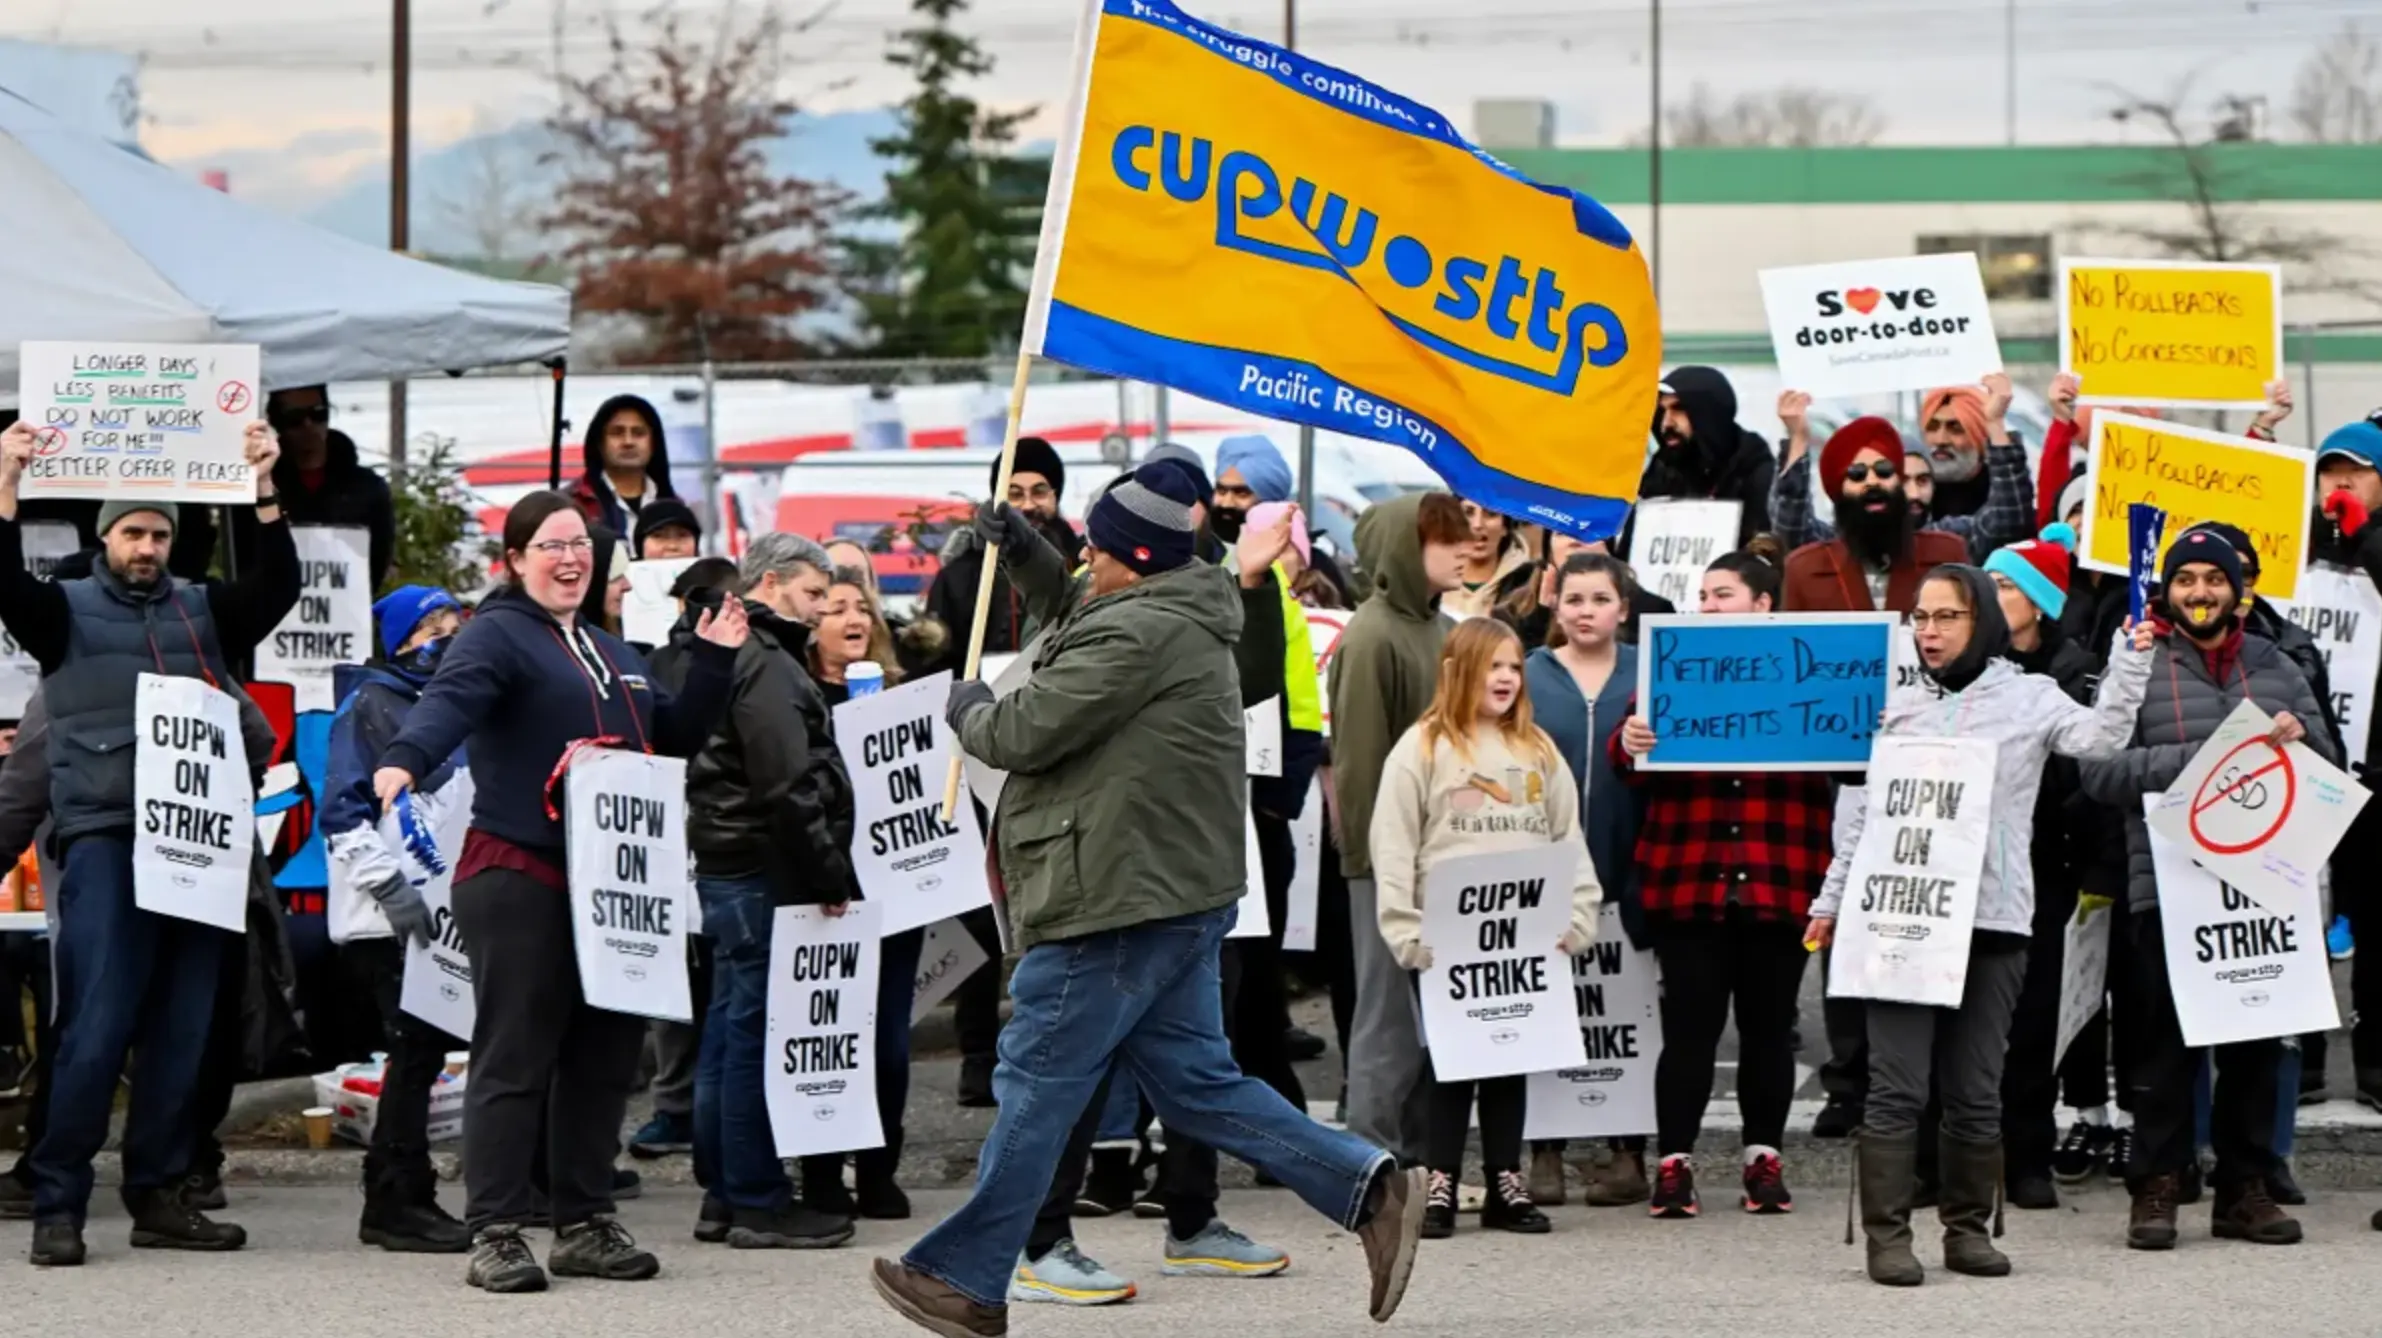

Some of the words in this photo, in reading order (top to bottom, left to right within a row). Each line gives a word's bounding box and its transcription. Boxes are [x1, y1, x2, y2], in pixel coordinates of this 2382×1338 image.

[1186, 24, 1293, 76] ruggle
[1795, 316, 1970, 347] door-to-door
[72, 354, 147, 371] LONGER
[159, 356, 199, 374] DAYS
[54, 382, 95, 398] LESS
[107, 383, 187, 399] BENEFITS
[1239, 364, 1323, 409] Pacific
[1334, 385, 1439, 452] Region
[46, 408, 78, 426] DO
[90, 408, 135, 425] NOT
[146, 409, 204, 428] WORK
[82, 430, 119, 447] FOR
[30, 456, 109, 478] BETTER
[119, 458, 175, 478] OFFER
[1648, 535, 1714, 566] CUPW
[300, 561, 348, 589] UPW
[1658, 572, 1688, 603] ON
[300, 596, 331, 624] ON
[275, 631, 354, 660] STRIKE
[152, 715, 226, 760] CUPW
[863, 715, 933, 768] CUPW
[175, 759, 210, 798] ON
[888, 763, 923, 804] ON
[2216, 765, 2268, 810] SSD
[594, 792, 666, 839] CUPW
[1885, 778, 1965, 820] CUPW
[145, 799, 233, 850] STRIKE
[616, 843, 647, 884] ON
[1893, 826, 1933, 866] ON
[591, 888, 673, 937] STRIKE
[1458, 878, 1546, 916] CUPW
[1861, 874, 1956, 918] STRIKE
[1478, 918, 1518, 952] ON
[2194, 915, 2299, 963] STRIKE
[793, 942, 860, 982] CUPW
[1448, 956, 1549, 1001] STRIKE
[809, 989, 839, 1026] ON
[783, 1033, 859, 1075] STRIKE
[1580, 1024, 1640, 1060] RIKE
